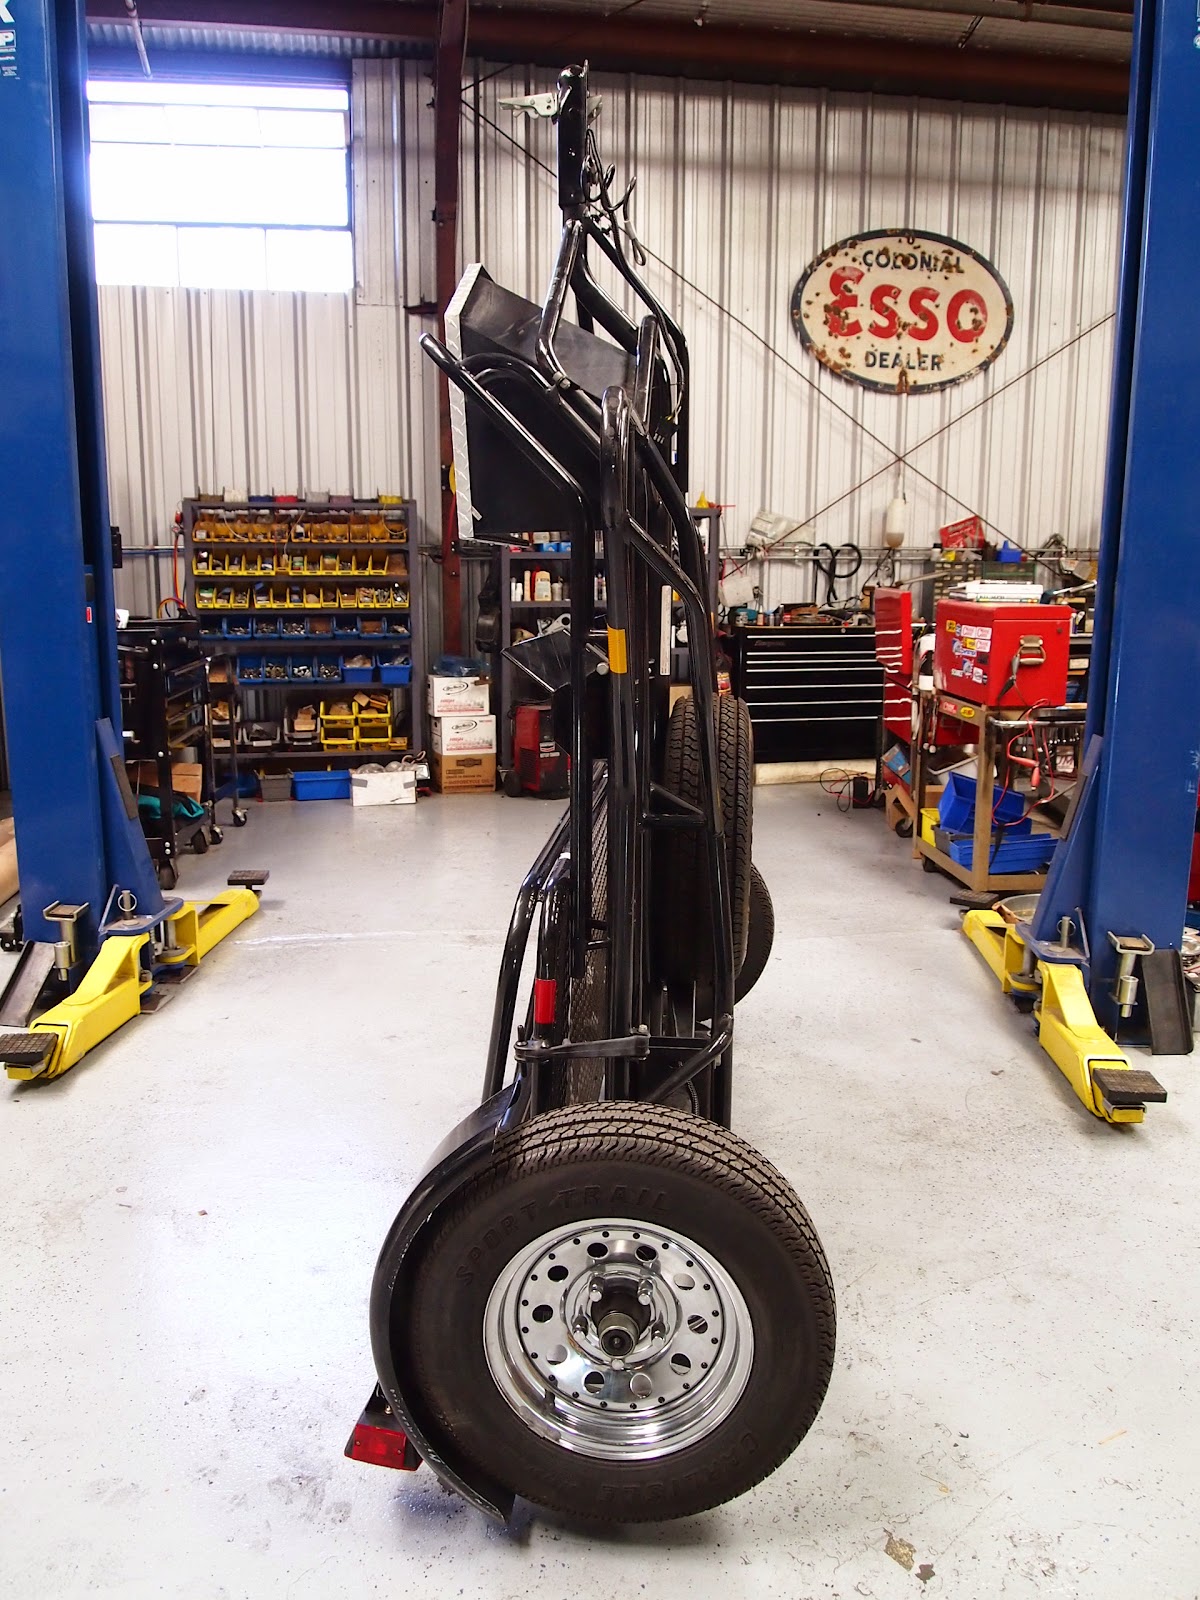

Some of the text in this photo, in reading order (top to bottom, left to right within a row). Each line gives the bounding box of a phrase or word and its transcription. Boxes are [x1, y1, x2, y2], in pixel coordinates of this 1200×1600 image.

[862, 249, 965, 274] COLONIAL
[865, 350, 942, 371] DEALER
[455, 1185, 668, 1287] SPORT TRAIL
